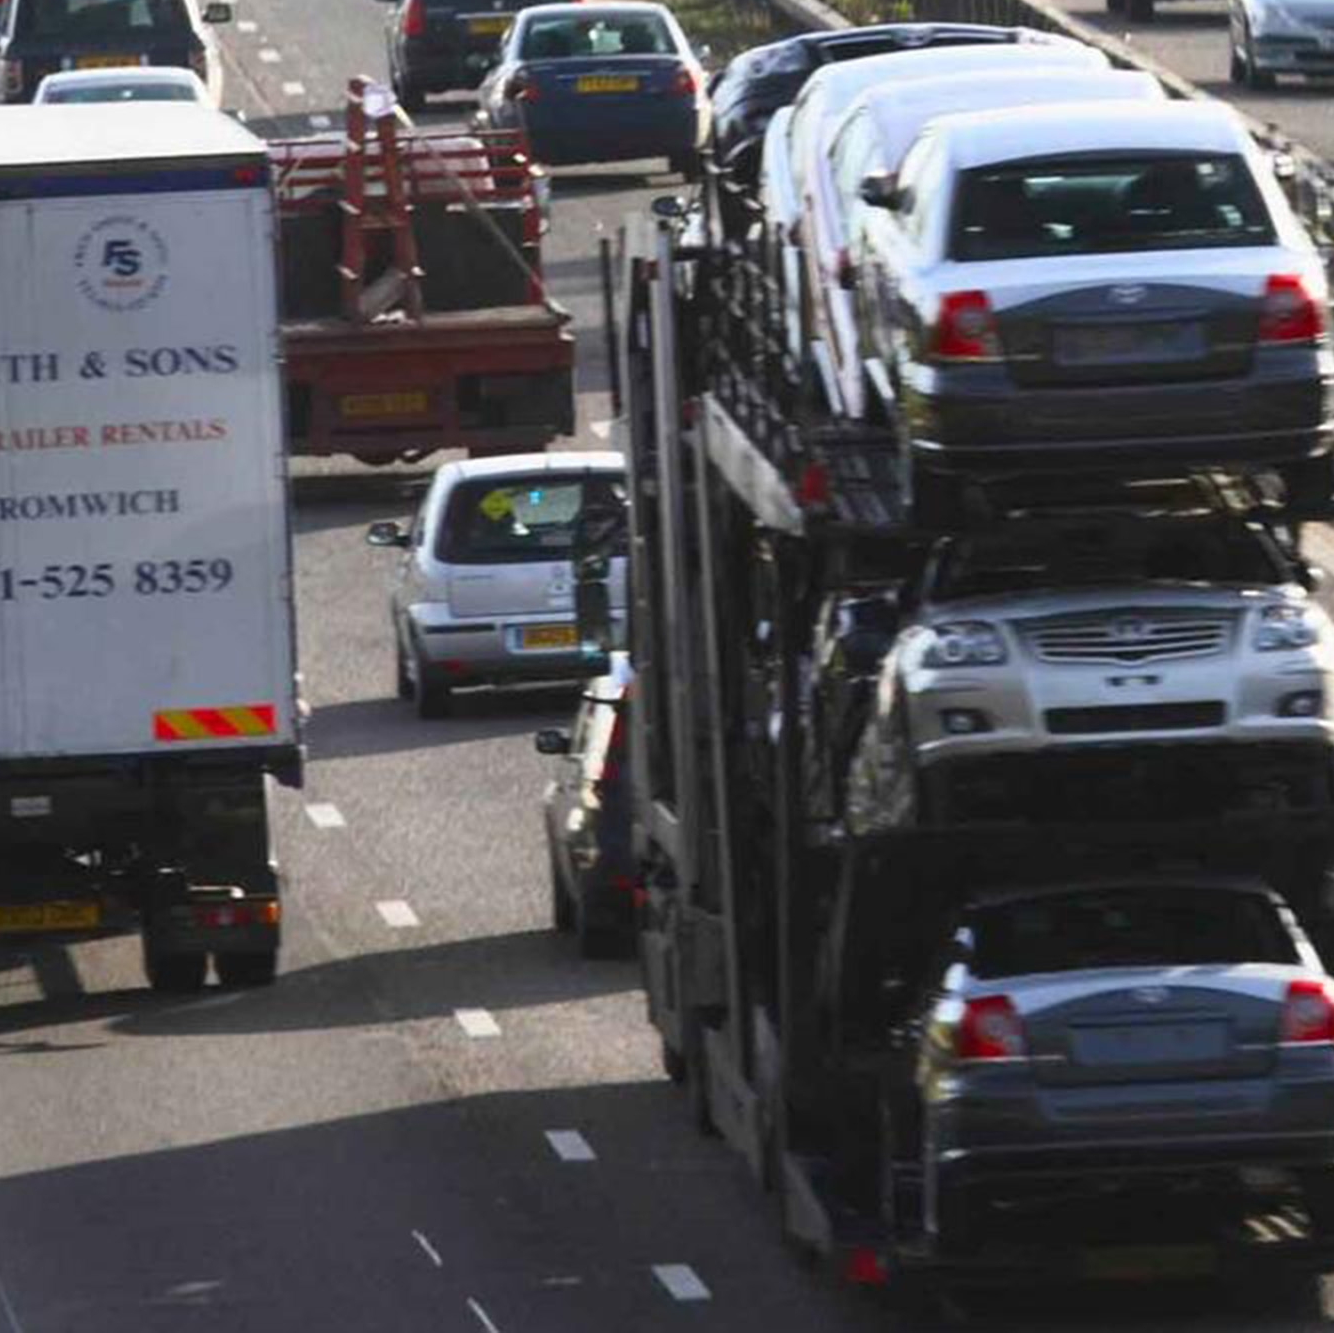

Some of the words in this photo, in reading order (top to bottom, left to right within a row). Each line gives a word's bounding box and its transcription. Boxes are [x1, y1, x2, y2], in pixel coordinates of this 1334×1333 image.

[101, 238, 142, 277] FS
[79, 350, 109, 381] &
[123, 344, 241, 378] SONS
[101, 418, 228, 447] RENTALS
[134, 558, 235, 597] 8359
